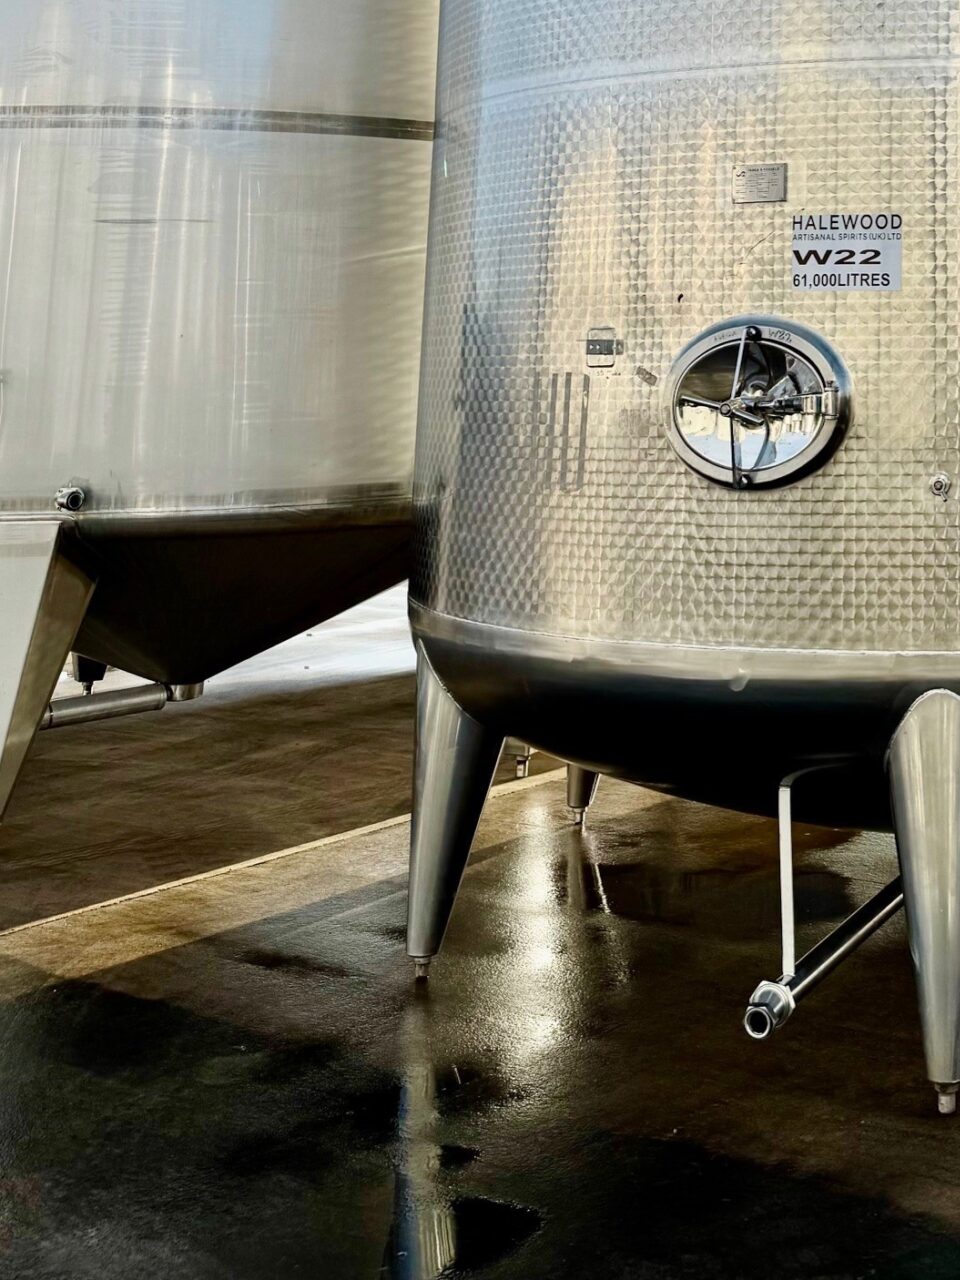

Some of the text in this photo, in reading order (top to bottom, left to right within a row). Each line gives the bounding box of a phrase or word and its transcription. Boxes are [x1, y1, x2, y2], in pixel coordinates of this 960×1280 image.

[792, 214, 903, 230] HALEWOOD
[792, 233, 836, 241] ARTISANAL
[887, 232, 902, 240] LTD
[792, 249, 881, 265] W22
